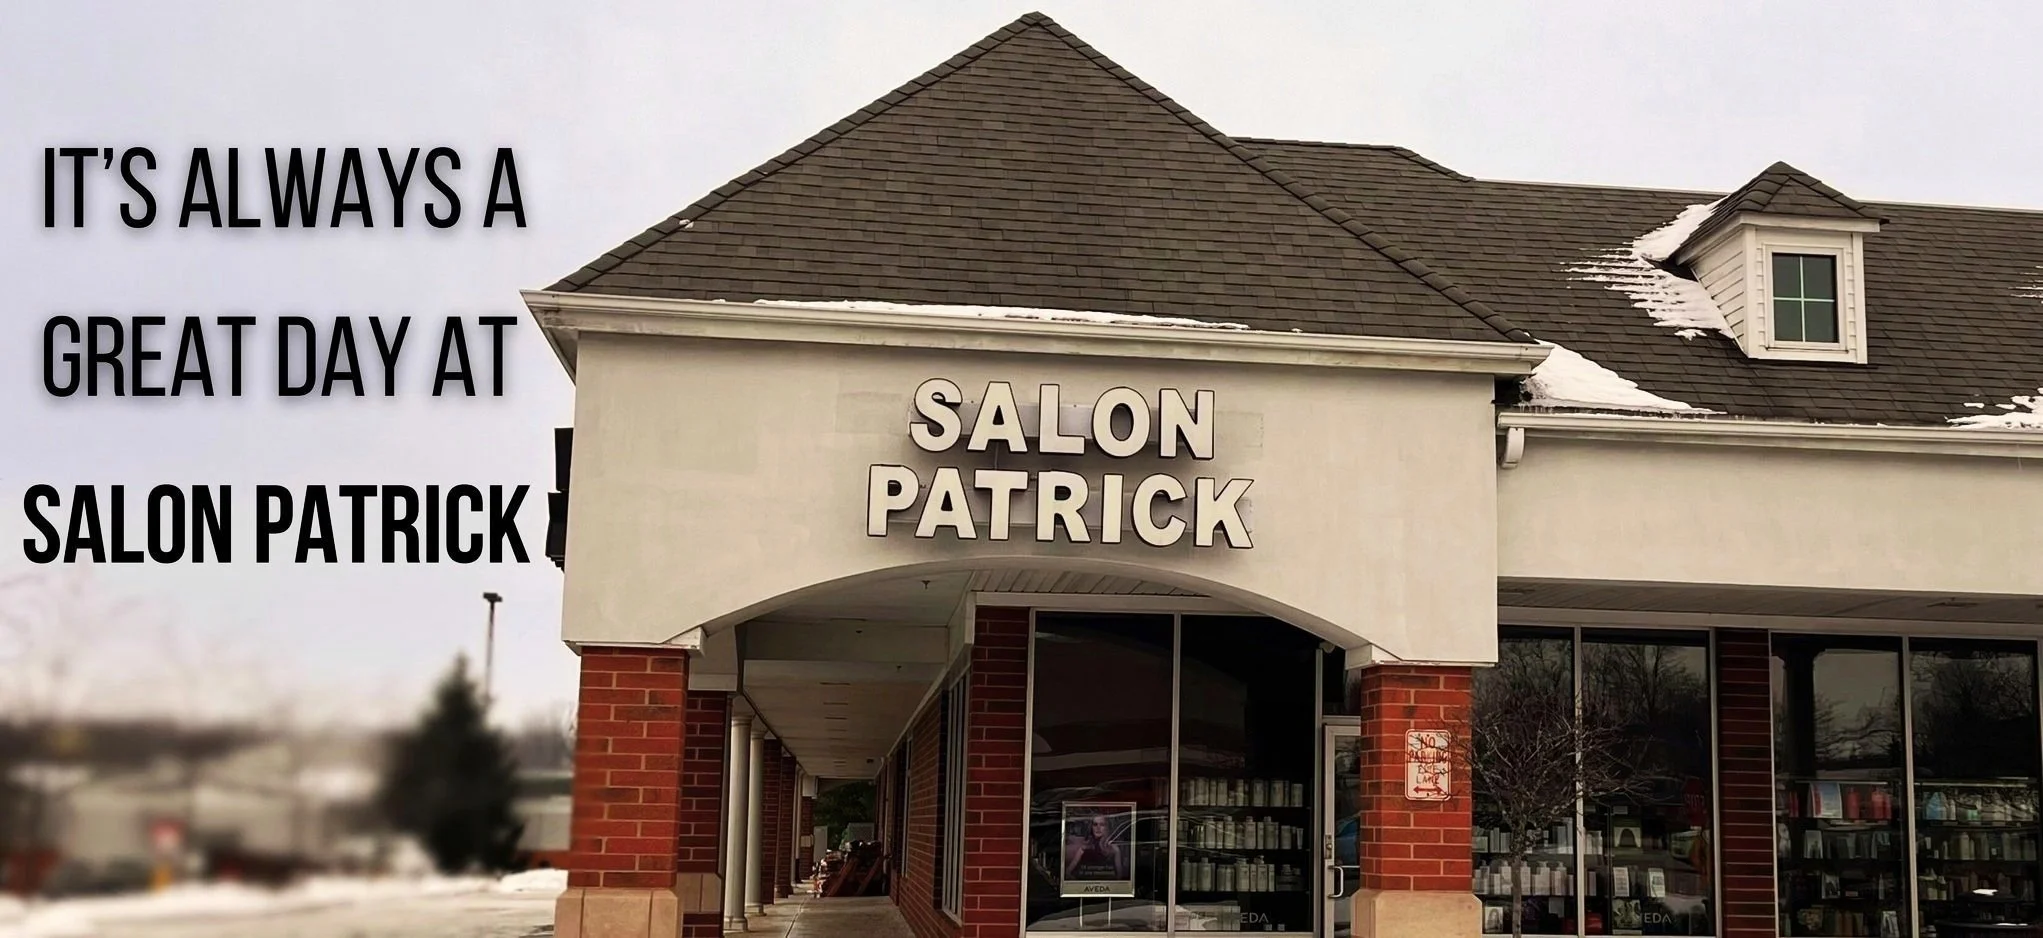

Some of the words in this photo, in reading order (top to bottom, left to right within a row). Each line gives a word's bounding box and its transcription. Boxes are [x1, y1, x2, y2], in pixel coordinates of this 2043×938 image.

[908, 378, 1215, 460] SALON
[867, 464, 1254, 549] PATRICK
[1420, 736, 1436, 749] NO
